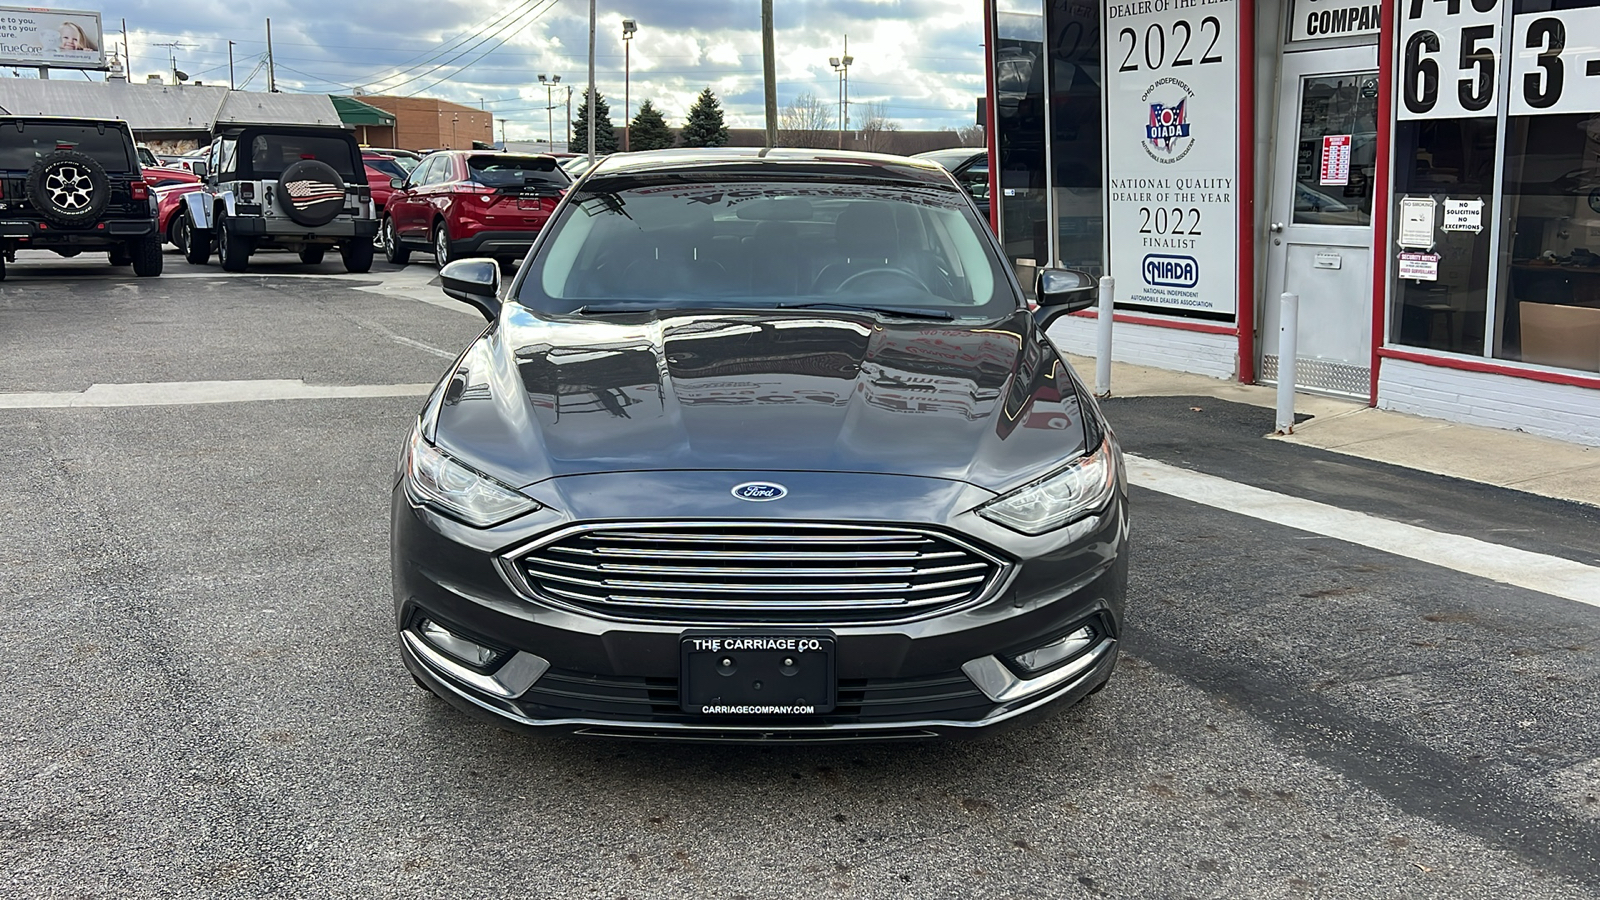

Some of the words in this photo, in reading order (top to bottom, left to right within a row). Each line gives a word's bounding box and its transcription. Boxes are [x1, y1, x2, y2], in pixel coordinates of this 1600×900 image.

[1109, 0, 1152, 18] DEALER
[1154, 0, 1169, 12] OF
[1119, 16, 1222, 72] 2022
[1142, 85, 1155, 102] OHIO
[1154, 78, 1195, 98] INDEPENDENT
[1151, 125, 1182, 137] OIADA
[1111, 179, 1171, 188] NATIONAL
[1176, 179, 1232, 190] QUALITY
[1112, 193, 1152, 201] DEALER
[1156, 193, 1169, 202] OF
[1174, 193, 1195, 202] THE
[1201, 193, 1230, 202] YEAR
[1139, 207, 1202, 235] 2022
[1143, 238, 1196, 248] FINALIST
[1147, 261, 1193, 280] NIADA
[1180, 299, 1212, 308] ASSOCIATION
[744, 486, 774, 496] Ford
[693, 640, 720, 650] THE
[724, 639, 796, 650] CARRIAGE
[798, 640, 822, 650] CO.
